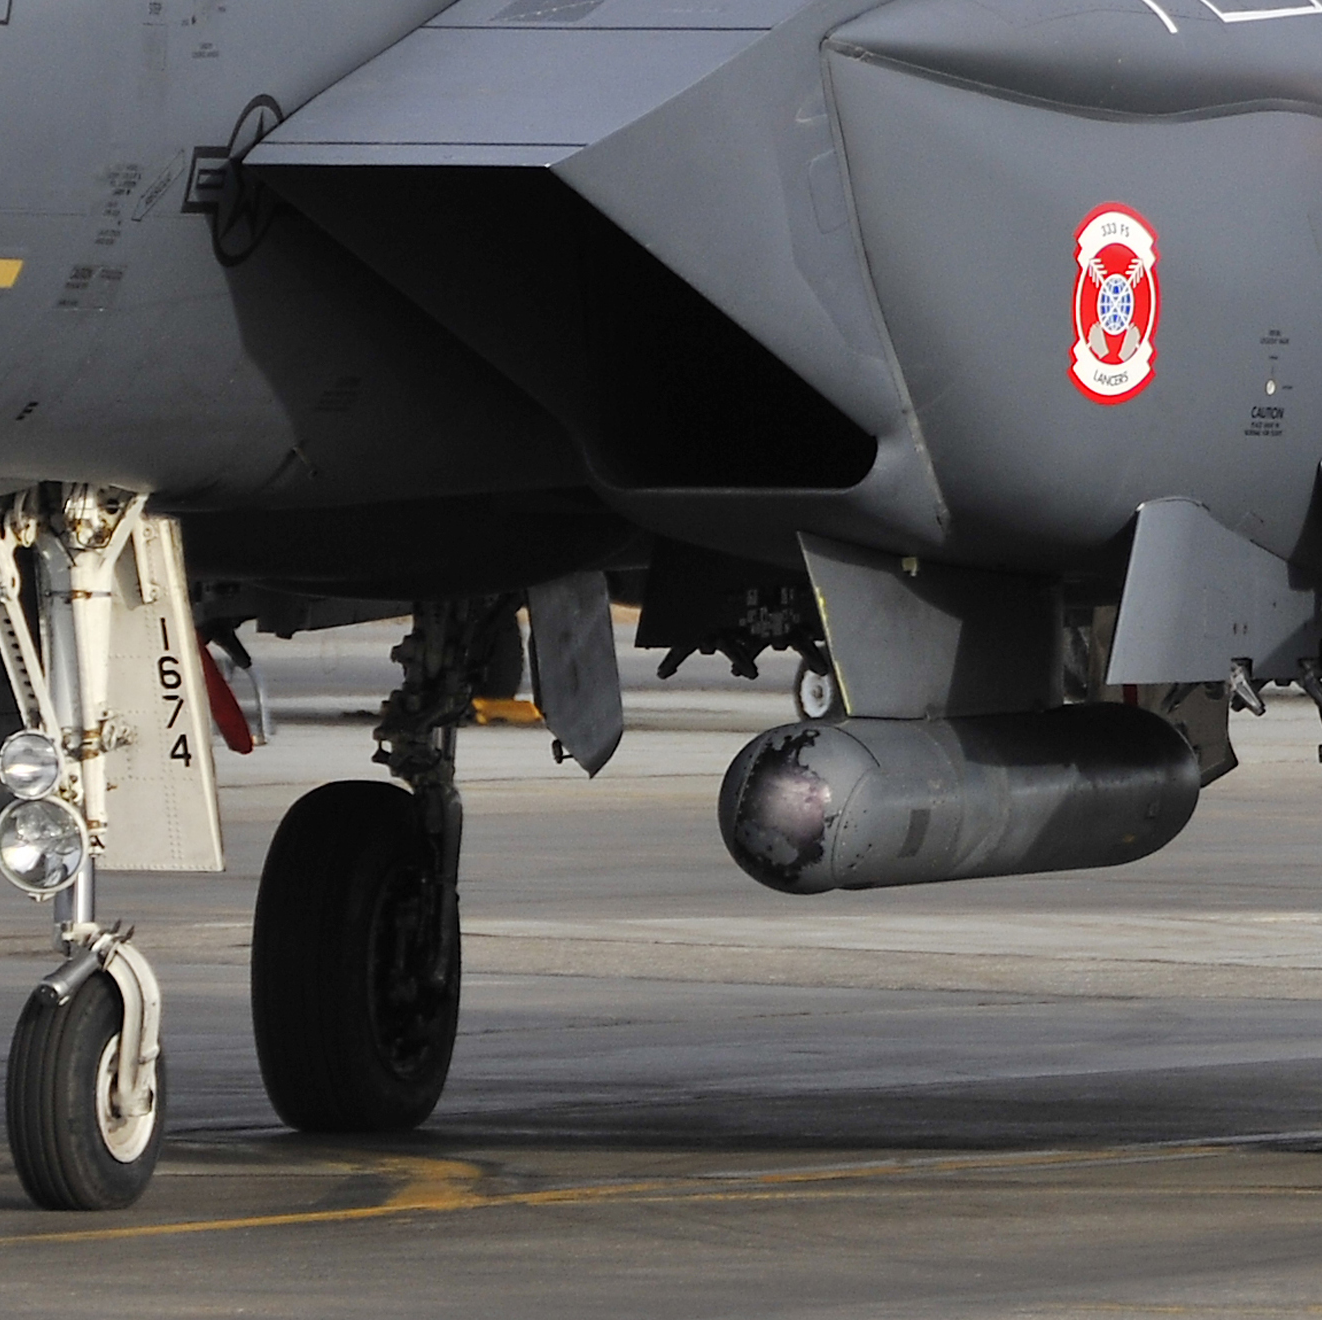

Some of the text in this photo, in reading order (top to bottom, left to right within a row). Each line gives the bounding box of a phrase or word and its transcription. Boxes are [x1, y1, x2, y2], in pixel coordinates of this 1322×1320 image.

[1101, 222, 1130, 238] 333 FS
[1093, 370, 1129, 387] LANCERS
[157, 617, 192, 767] 1674
